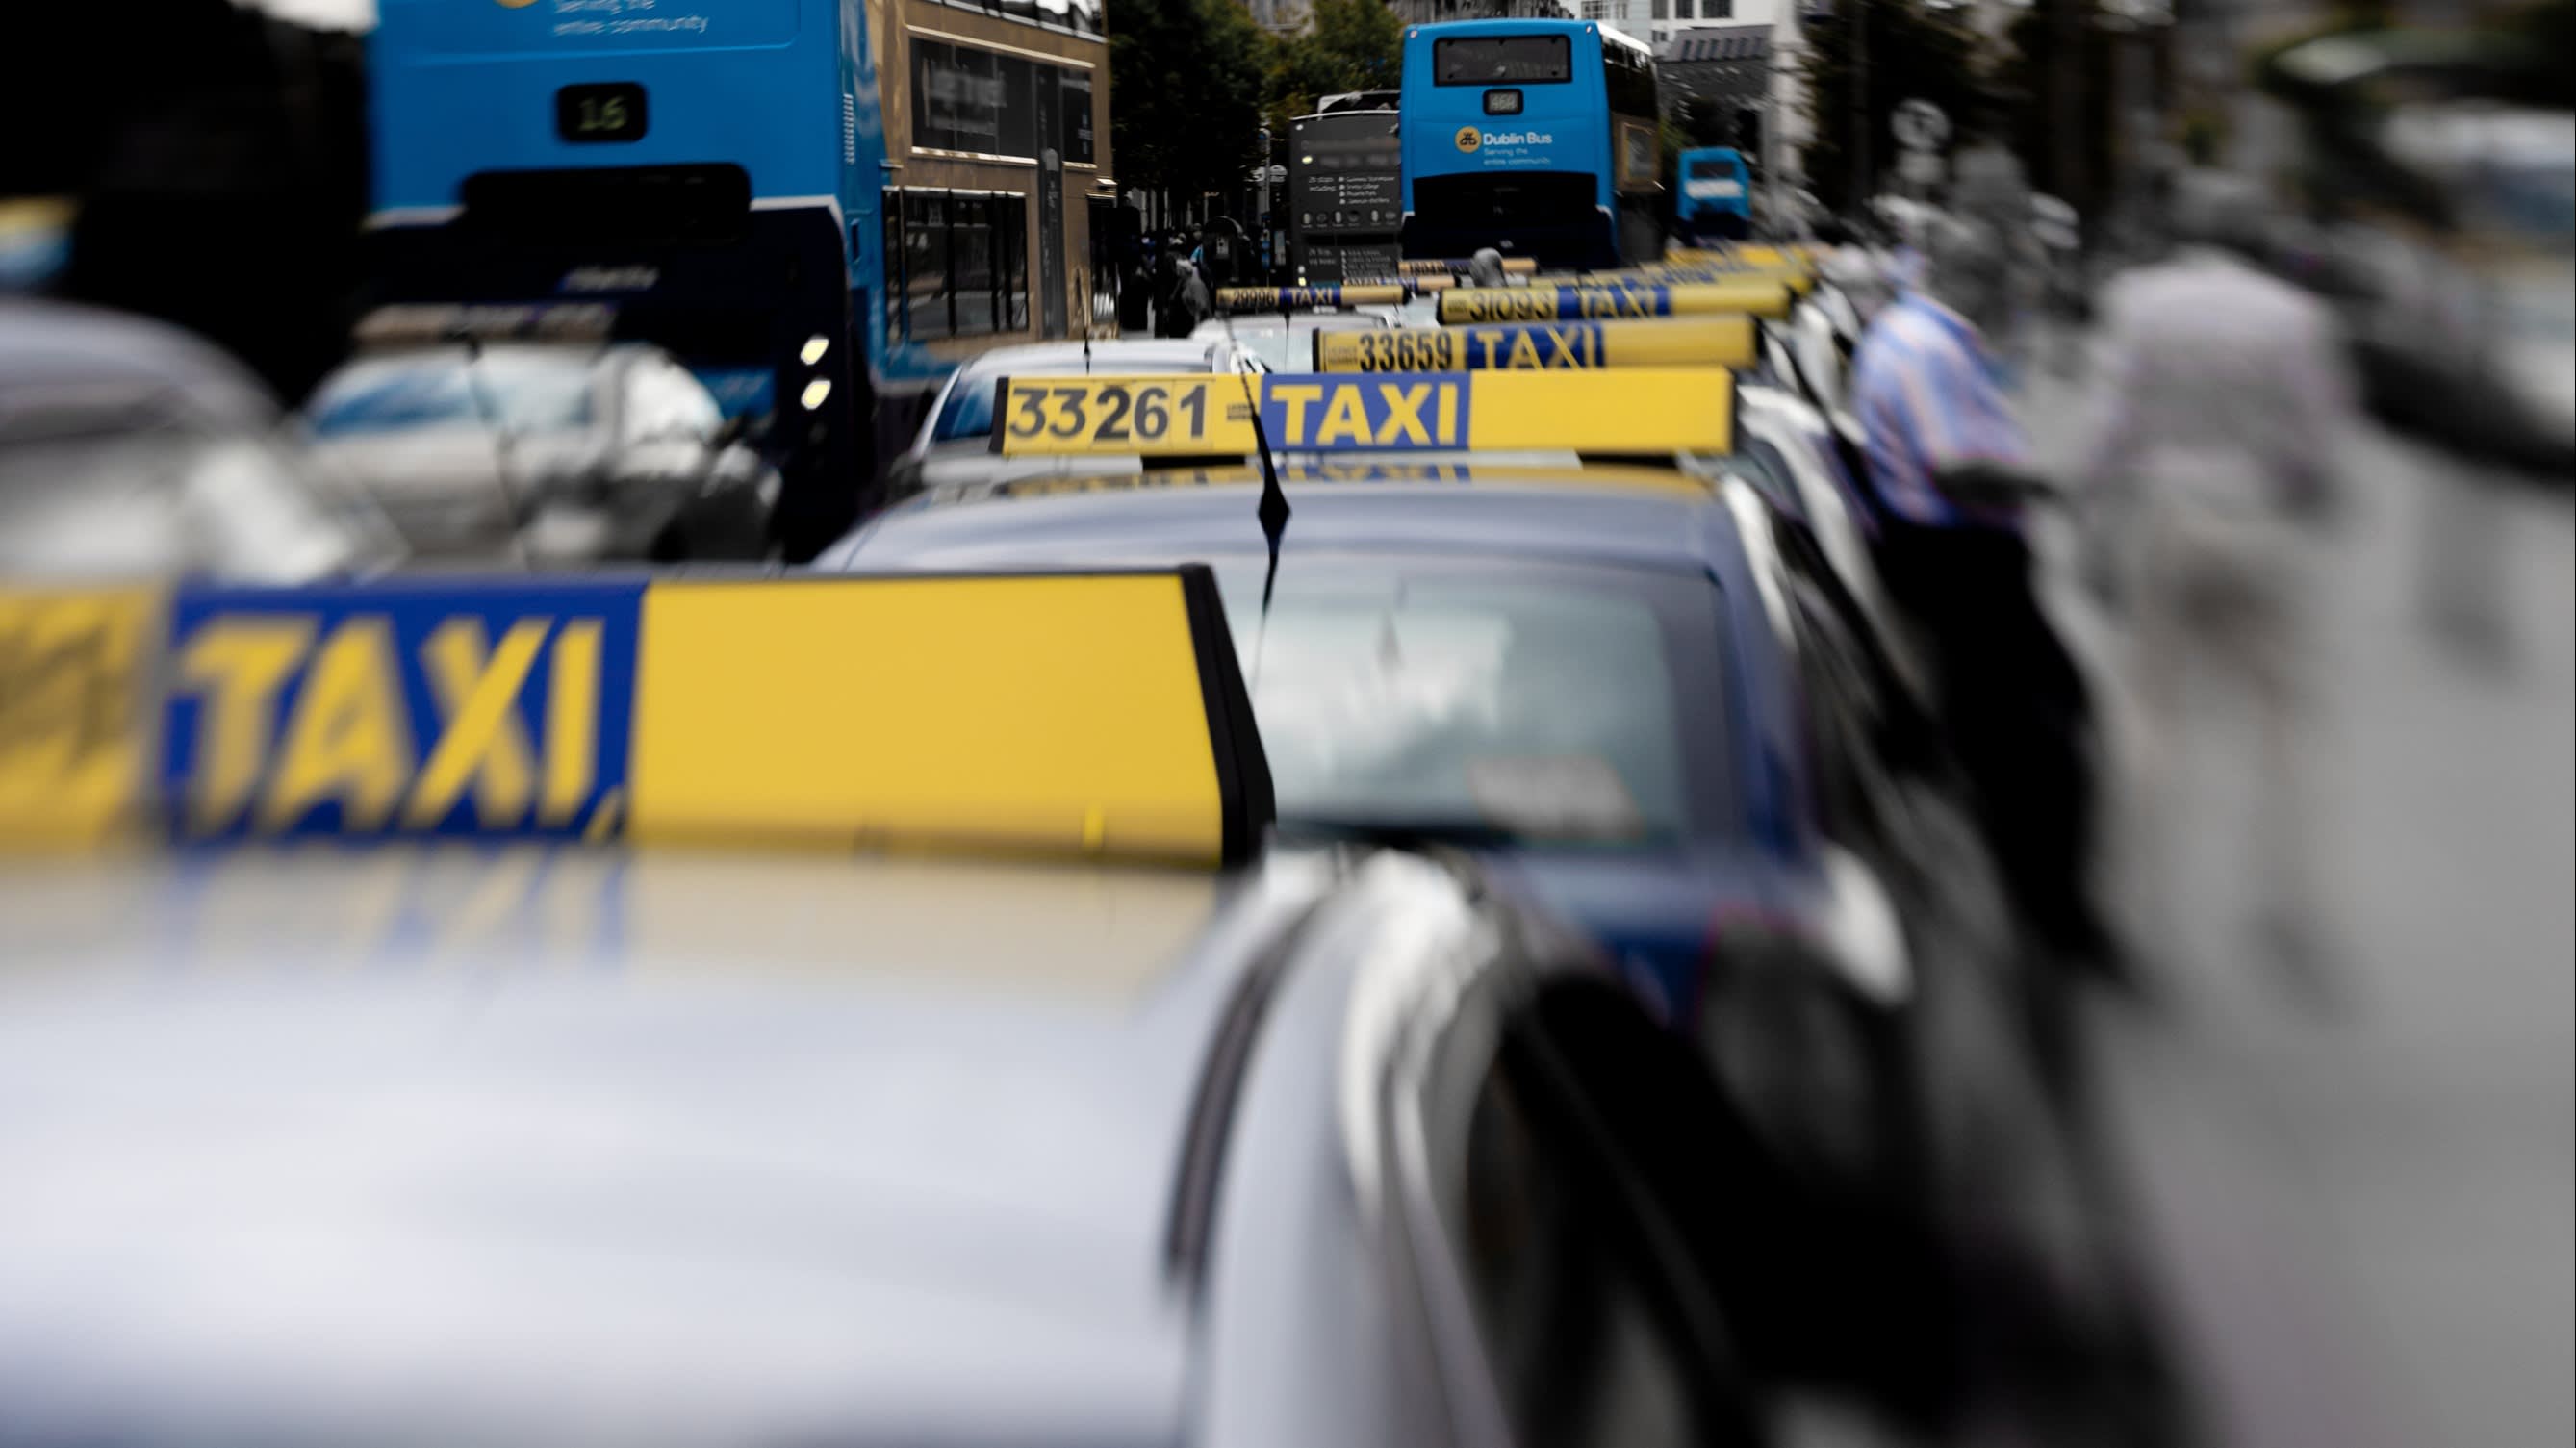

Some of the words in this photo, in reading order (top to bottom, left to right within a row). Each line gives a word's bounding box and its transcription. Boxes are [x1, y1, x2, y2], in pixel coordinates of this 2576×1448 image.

[579, 96, 626, 131] 16
[1483, 133, 1525, 145] Dublin
[1526, 132, 1553, 144] Bus
[1289, 287, 1334, 306] TAXI
[1469, 291, 1553, 322] 31093
[1578, 290, 1658, 318] TAXI
[1359, 332, 1453, 372] 33659
[1476, 328, 1598, 369] TAXI
[1007, 385, 1207, 441] 33261
[1269, 382, 1459, 445] TAXI
[171, 610, 606, 835] TAXI
